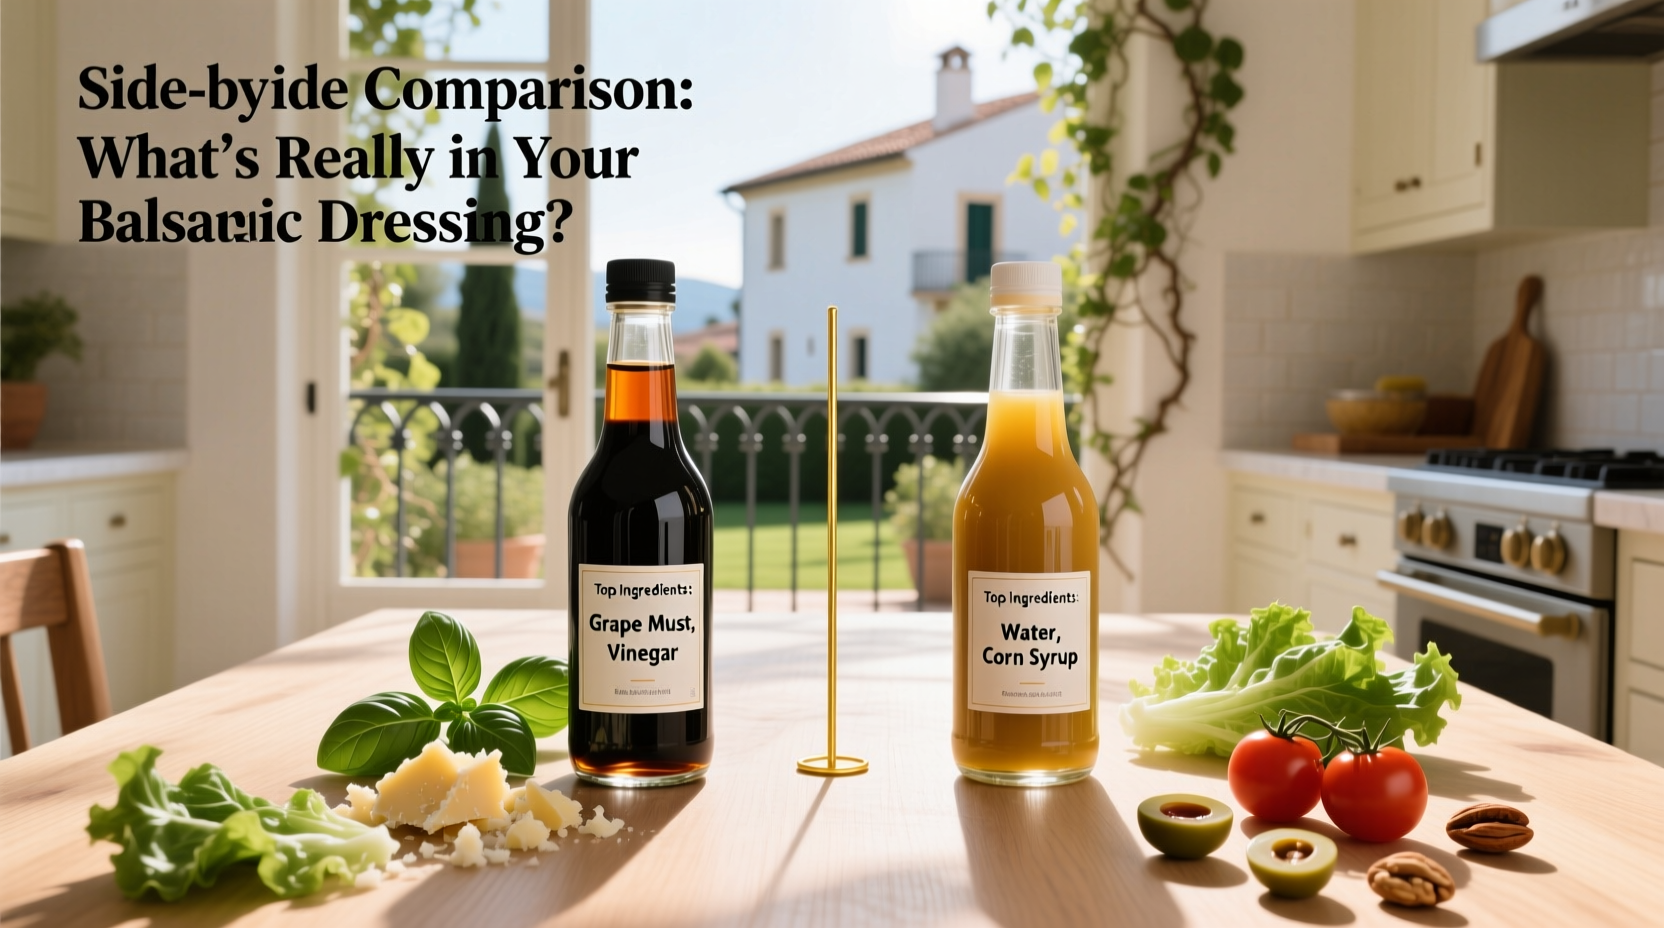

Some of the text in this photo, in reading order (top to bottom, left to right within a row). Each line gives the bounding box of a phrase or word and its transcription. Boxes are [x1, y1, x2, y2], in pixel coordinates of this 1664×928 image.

[594, 583, 617, 599] Top
[984, 591, 1007, 608] Top
[589, 613, 695, 638] Grape Must,
[1001, 623, 1061, 644] Water,
[607, 643, 679, 667] Vinegar
[982, 646, 1079, 671] Corn Syrup
